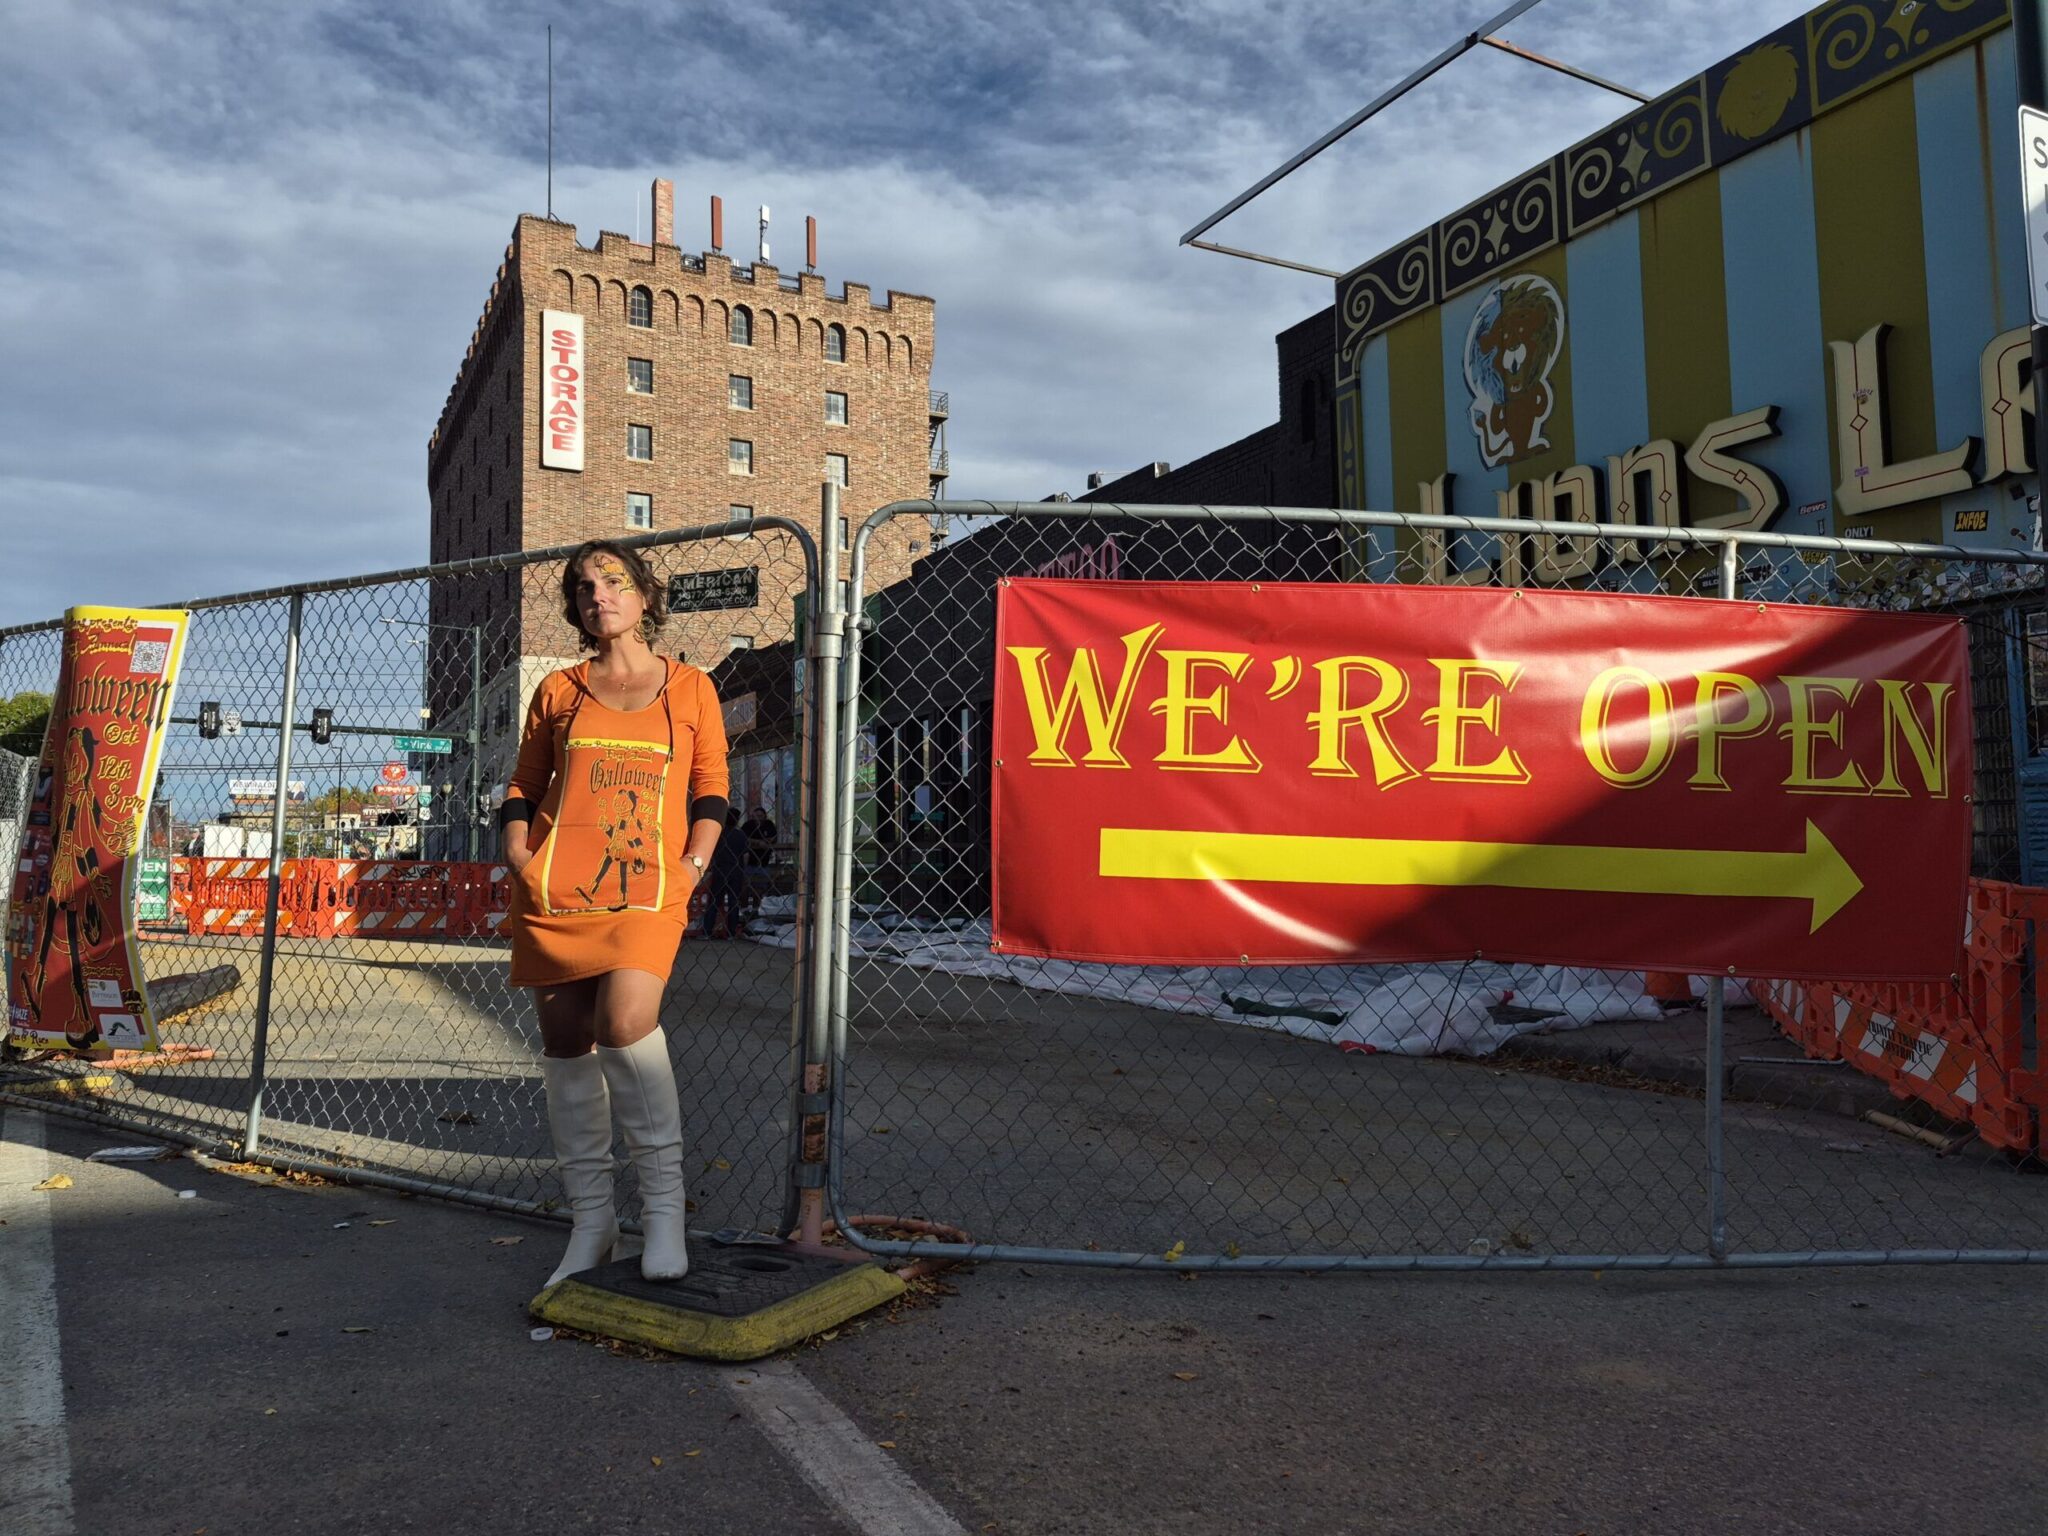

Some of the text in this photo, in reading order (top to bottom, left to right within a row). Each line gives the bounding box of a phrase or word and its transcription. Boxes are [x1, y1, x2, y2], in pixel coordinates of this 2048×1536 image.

[548, 329, 579, 452] STORAGE
[673, 572, 752, 591] AMERICAN
[1006, 622, 1956, 799] WE'RE OPEN
[103, 721, 140, 746] Oct
[97, 755, 133, 780] 12th
[590, 758, 666, 796] Galloween
[104, 781, 146, 824] 3 pm
